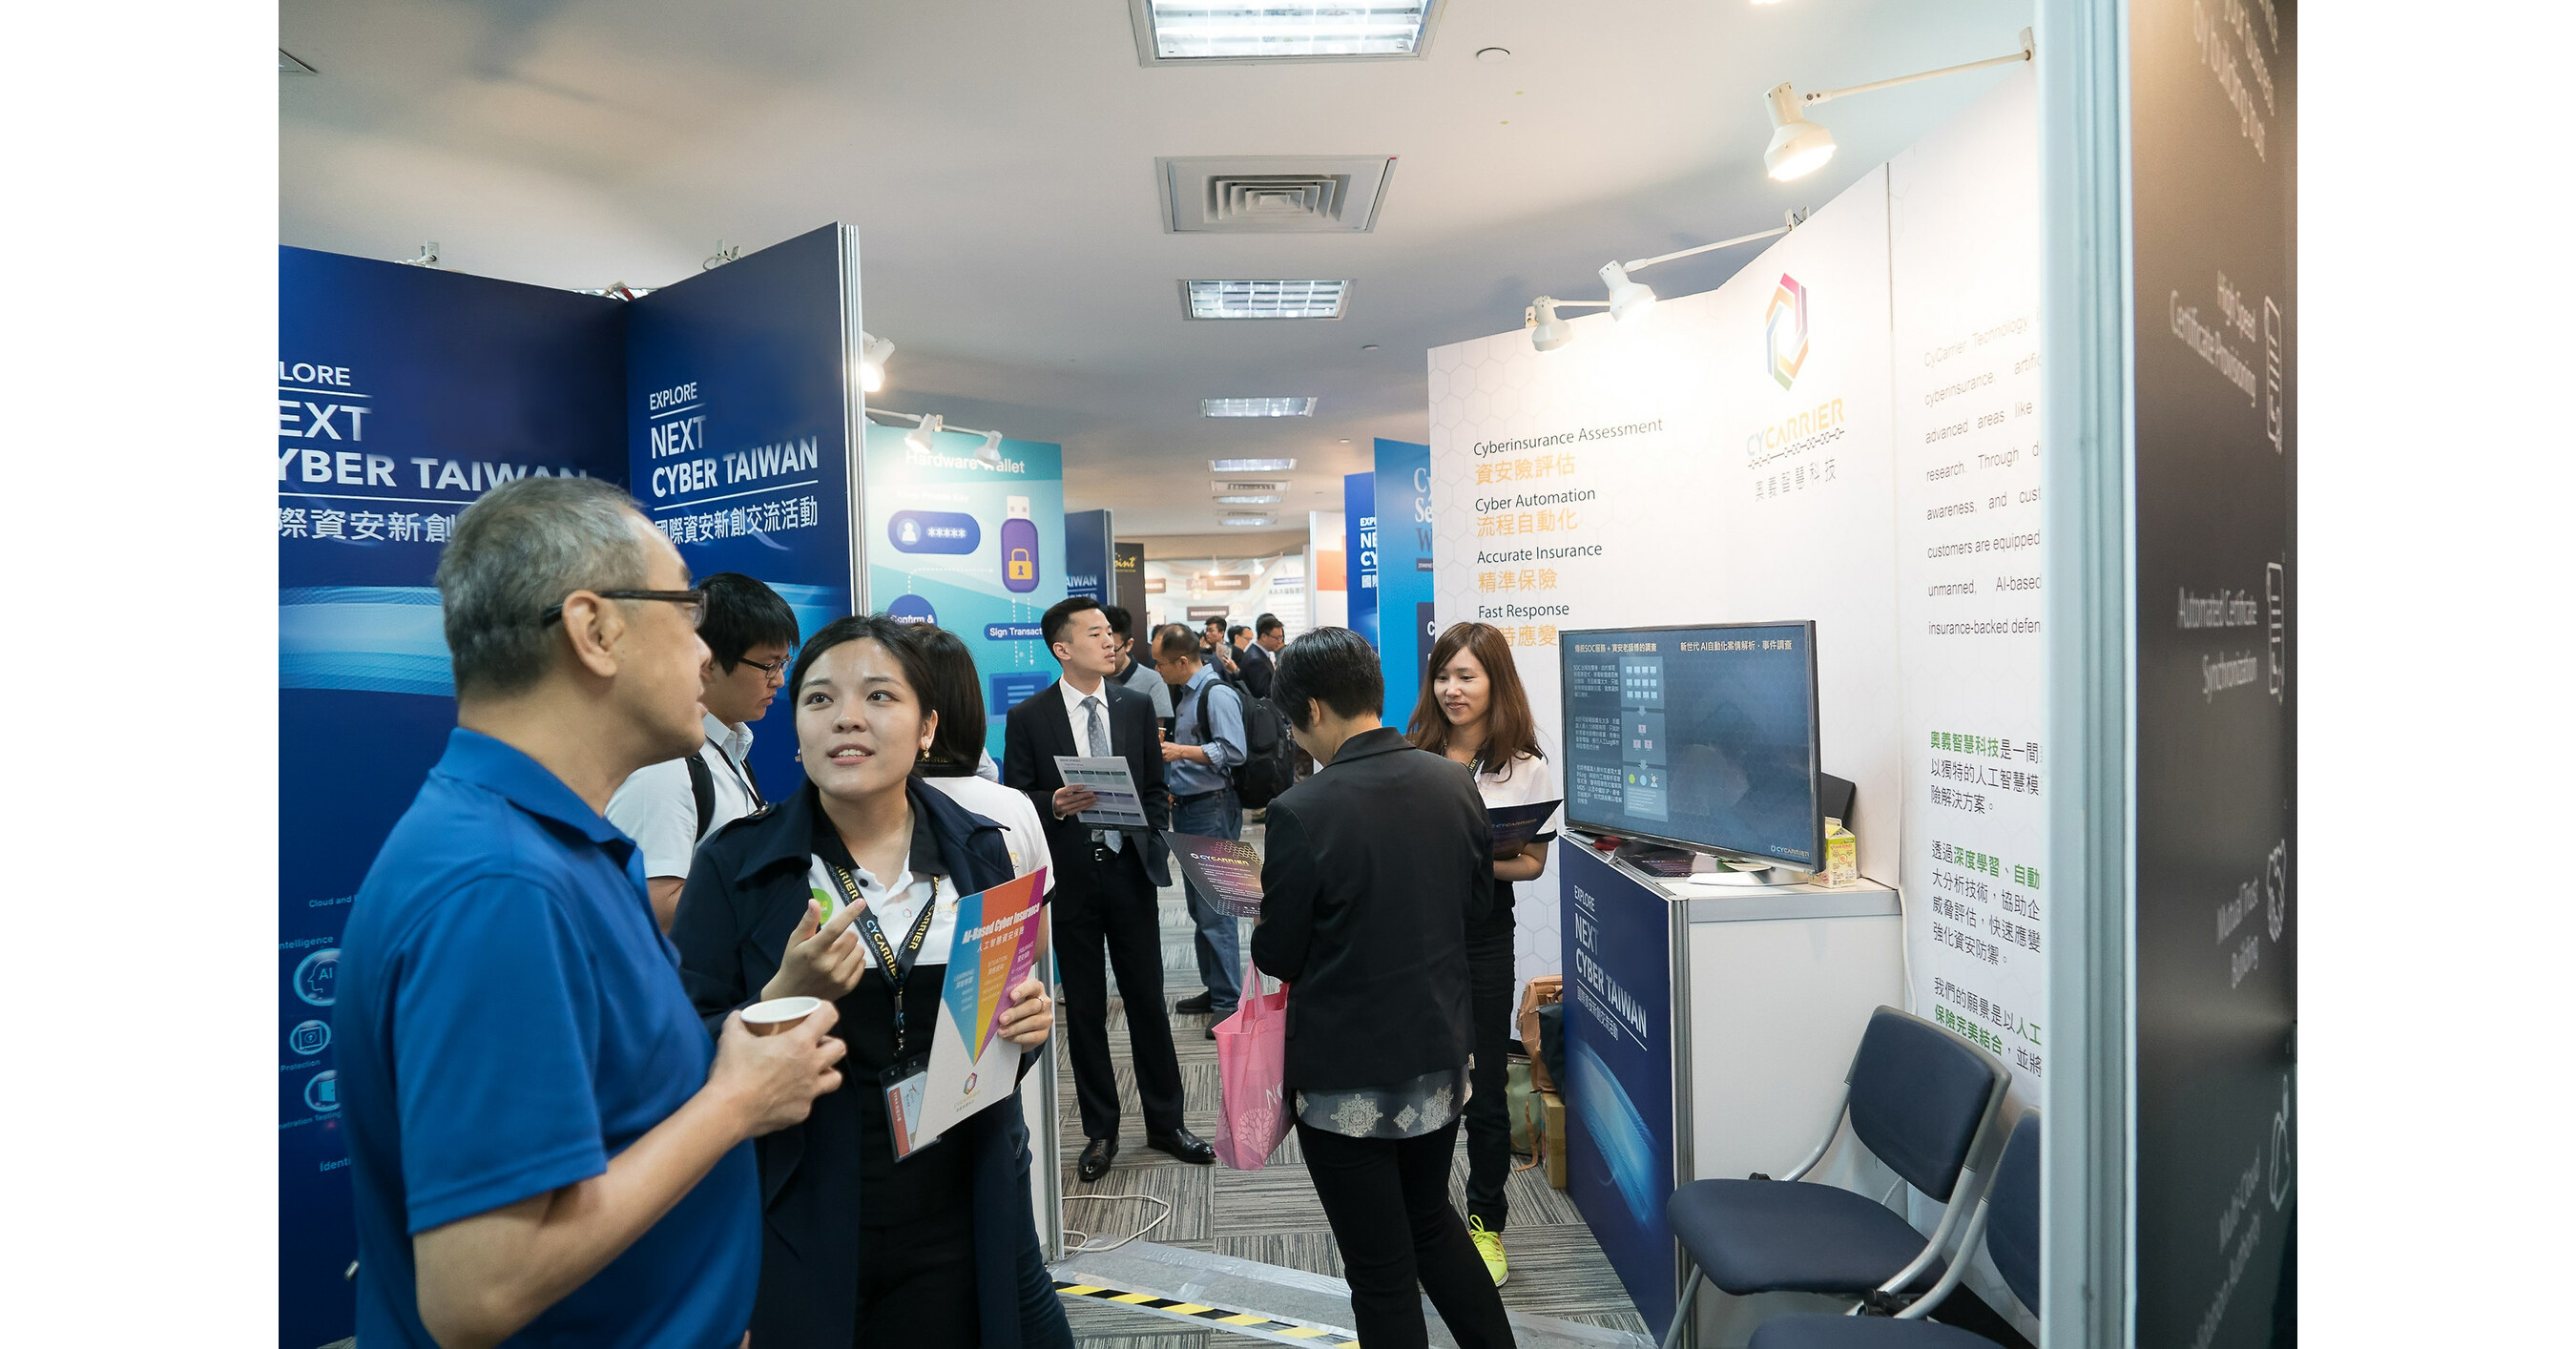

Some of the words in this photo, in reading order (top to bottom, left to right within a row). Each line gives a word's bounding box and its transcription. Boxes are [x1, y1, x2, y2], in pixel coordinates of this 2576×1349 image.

[1923, 341, 1967, 368] CyCarrier
[1972, 312, 2029, 347] Technology
[279, 361, 351, 386] LORE
[1924, 369, 1997, 406] cyberinsurance,
[650, 382, 697, 410] EXPLORE
[279, 400, 372, 442] EXT
[1747, 398, 1844, 457] CYCARRIER
[1925, 420, 1968, 445] advanced
[1977, 408, 2005, 429] areas
[2015, 399, 2033, 419] like
[651, 415, 706, 459] NEXT
[1473, 432, 1574, 458] Cyberinsurance
[1578, 418, 1663, 442] Assessment
[653, 458, 717, 498] CYBER
[723, 436, 818, 484] TAIWAN
[905, 450, 977, 470] Hardware
[1475, 452, 1577, 486] 資安險評估
[1926, 461, 1967, 483] research.
[1978, 446, 2019, 471] Through
[1475, 494, 1511, 514] Cyber
[1515, 488, 1596, 508] Automation
[1926, 501, 1978, 521] awareness,
[1988, 491, 2006, 510] and
[1477, 508, 1578, 538] 流程自動化
[1477, 548, 1532, 564] Accurate
[1536, 543, 1603, 560] Insurance
[1927, 540, 1972, 559] customers
[1975, 539, 1990, 553] are
[1993, 529, 2041, 553] equipped
[1478, 568, 1558, 593] 精準保險
[1928, 579, 1977, 598] unmanned,
[1996, 572, 2042, 592] AI-based
[1479, 605, 1503, 618] Fast
[1506, 602, 1569, 620] Response
[1928, 617, 2008, 636] insurance-backed
[2011, 618, 2041, 633] defen
[989, 627, 1008, 638] Sign
[1931, 731, 2039, 764] 奧義智慧科技是一間
[1931, 758, 2039, 796] 以獨特的人工智慧模
[1931, 784, 1993, 814] 險解決方案。
[1932, 840, 2040, 889] 透過深度學習、自動
[308, 899, 334, 908] Cloud
[336, 896, 352, 905] and
[1574, 884, 1595, 912] EXPLORE
[1932, 868, 2040, 921] 大分析技術，協助企
[962, 921, 995, 945] AI-Based
[1575, 913, 1599, 955] NEXT
[866, 920, 898, 979] CYCARRIE
[319, 967, 333, 981] AI
[1576, 948, 1604, 996] CYBER
[1606, 974, 1648, 1038] TAIWAN
[1935, 977, 2042, 1046] 我們的願景是以人工
